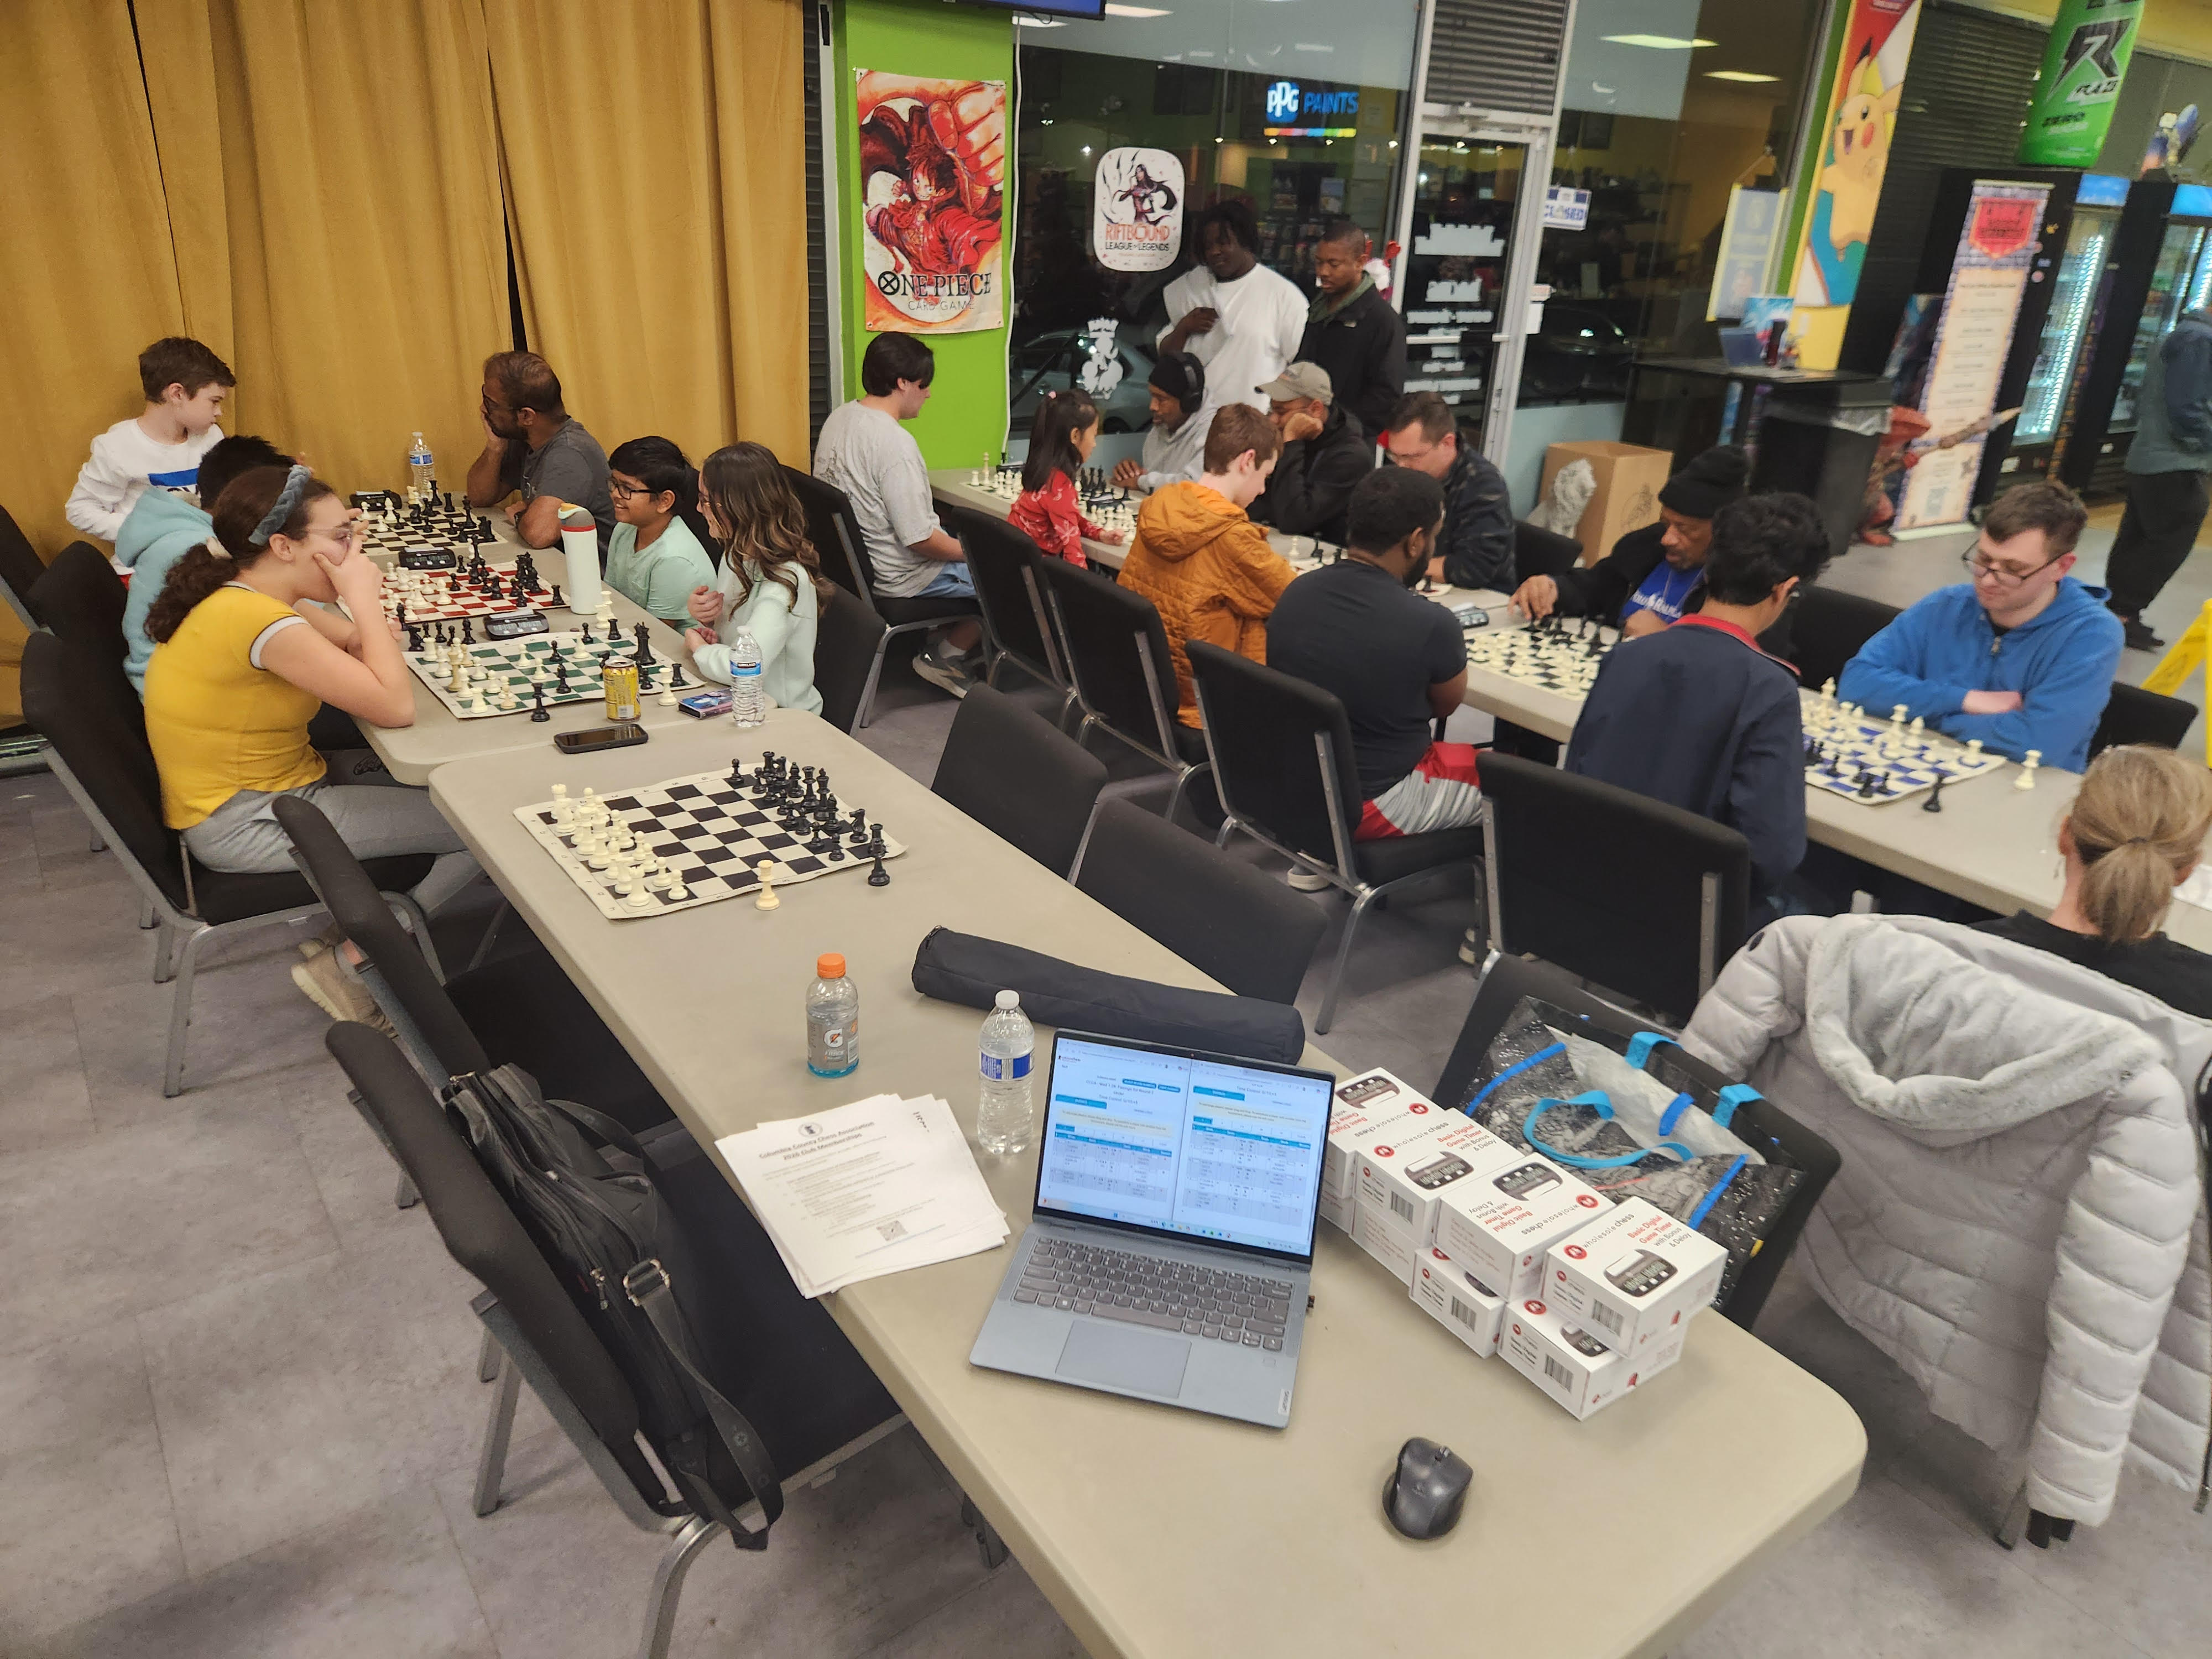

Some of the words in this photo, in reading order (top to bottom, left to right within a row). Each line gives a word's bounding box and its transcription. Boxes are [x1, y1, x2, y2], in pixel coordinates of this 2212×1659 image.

[1266, 81, 1300, 117] PPG
[1304, 91, 1359, 114] PAINTS
[1106, 223, 1170, 242] RIFTBOUND
[1105, 242, 1132, 250] LEAGUE
[1138, 243, 1169, 252] LEGENDS
[878, 270, 928, 297] ONE
[933, 272, 992, 297] PIECE
[908, 300, 935, 311] CARD
[940, 300, 975, 310] GAME
[1340, 1112, 1359, 1122] Game
[1353, 1117, 1368, 1127] Basic
[817, 1134, 837, 1143] Chess
[838, 1121, 875, 1136] Association
[1437, 1132, 1456, 1143] Basic
[1453, 1124, 1475, 1136] Digital
[1446, 1137, 1466, 1147] Game
[1464, 1129, 1483, 1140] Timer
[817, 1133, 863, 1151] Memberships
[1459, 1142, 1472, 1151] with
[1471, 1134, 1490, 1146] Bonus
[1479, 1139, 1497, 1150] Delay
[1468, 1203, 1489, 1214] Delay
[1476, 1208, 1497, 1219] Bonus
[1495, 1202, 1509, 1212] with
[1503, 1205, 1523, 1217] Game
[1484, 1214, 1504, 1225] Timer
[1515, 1211, 1533, 1222] Basic
[1493, 1219, 1516, 1233] Digital
[1627, 1225, 1646, 1239] Basic
[1642, 1214, 1664, 1229] Digital
[1639, 1231, 1658, 1244] Game
[1655, 1221, 1673, 1234] Timer
[1653, 1237, 1666, 1247] with
[1664, 1227, 1682, 1239] Bonus
[1673, 1232, 1692, 1245] Delay
